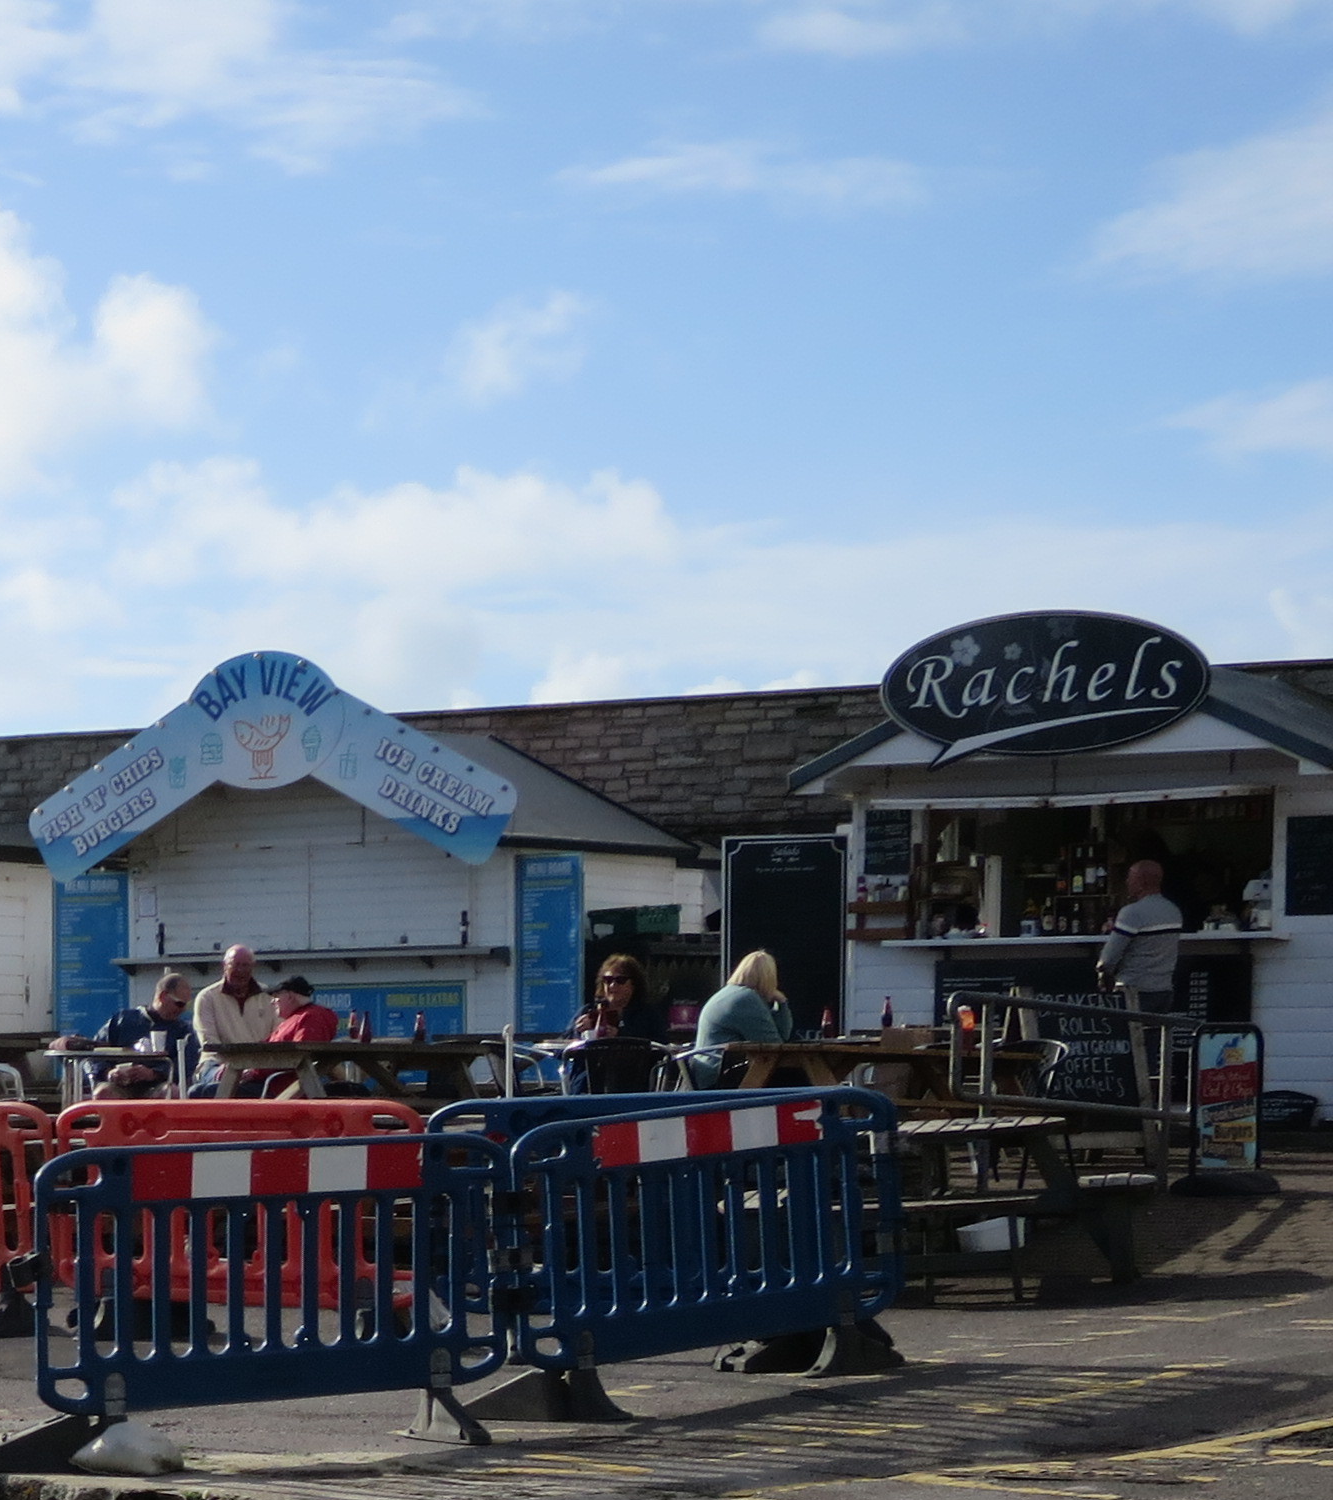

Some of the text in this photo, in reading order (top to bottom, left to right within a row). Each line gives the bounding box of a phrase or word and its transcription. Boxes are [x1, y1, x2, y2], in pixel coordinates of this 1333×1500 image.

[194, 659, 335, 721] BAY VIEW
[906, 636, 1183, 719] Rachels
[39, 803, 85, 845] FISH
[109, 746, 164, 796] CHIPS
[374, 736, 495, 818] ICE CREAM
[377, 774, 463, 836] DRINKS
[71, 787, 157, 858] BURGERS
[1059, 1017, 1113, 1036] ROLLS
